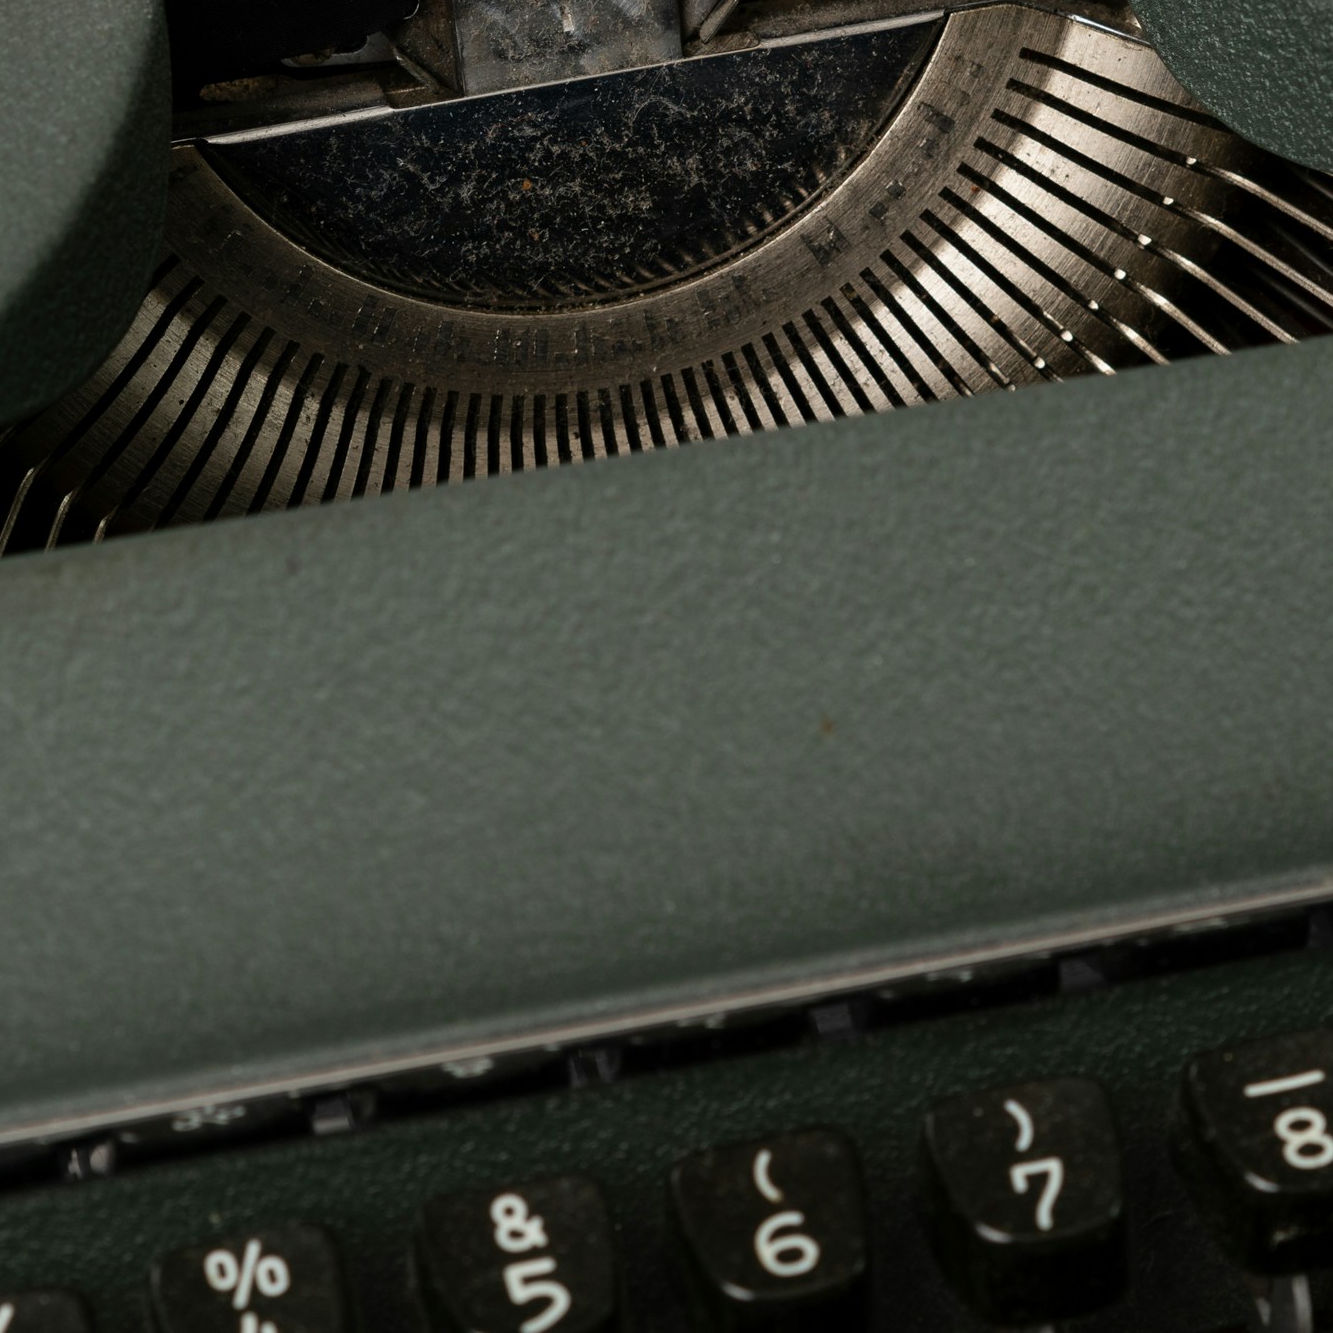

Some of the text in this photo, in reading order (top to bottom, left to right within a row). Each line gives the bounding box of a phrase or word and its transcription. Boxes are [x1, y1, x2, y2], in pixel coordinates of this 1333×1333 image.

[1005, 1100, 1033, 1151] )
[754, 1151, 780, 1201] (
[1010, 1157, 1063, 1229] 7
[491, 1194, 547, 1252] &
[755, 1211, 819, 1276] 6
[205, 1239, 289, 1309] %
[504, 1257, 570, 1333] 5
